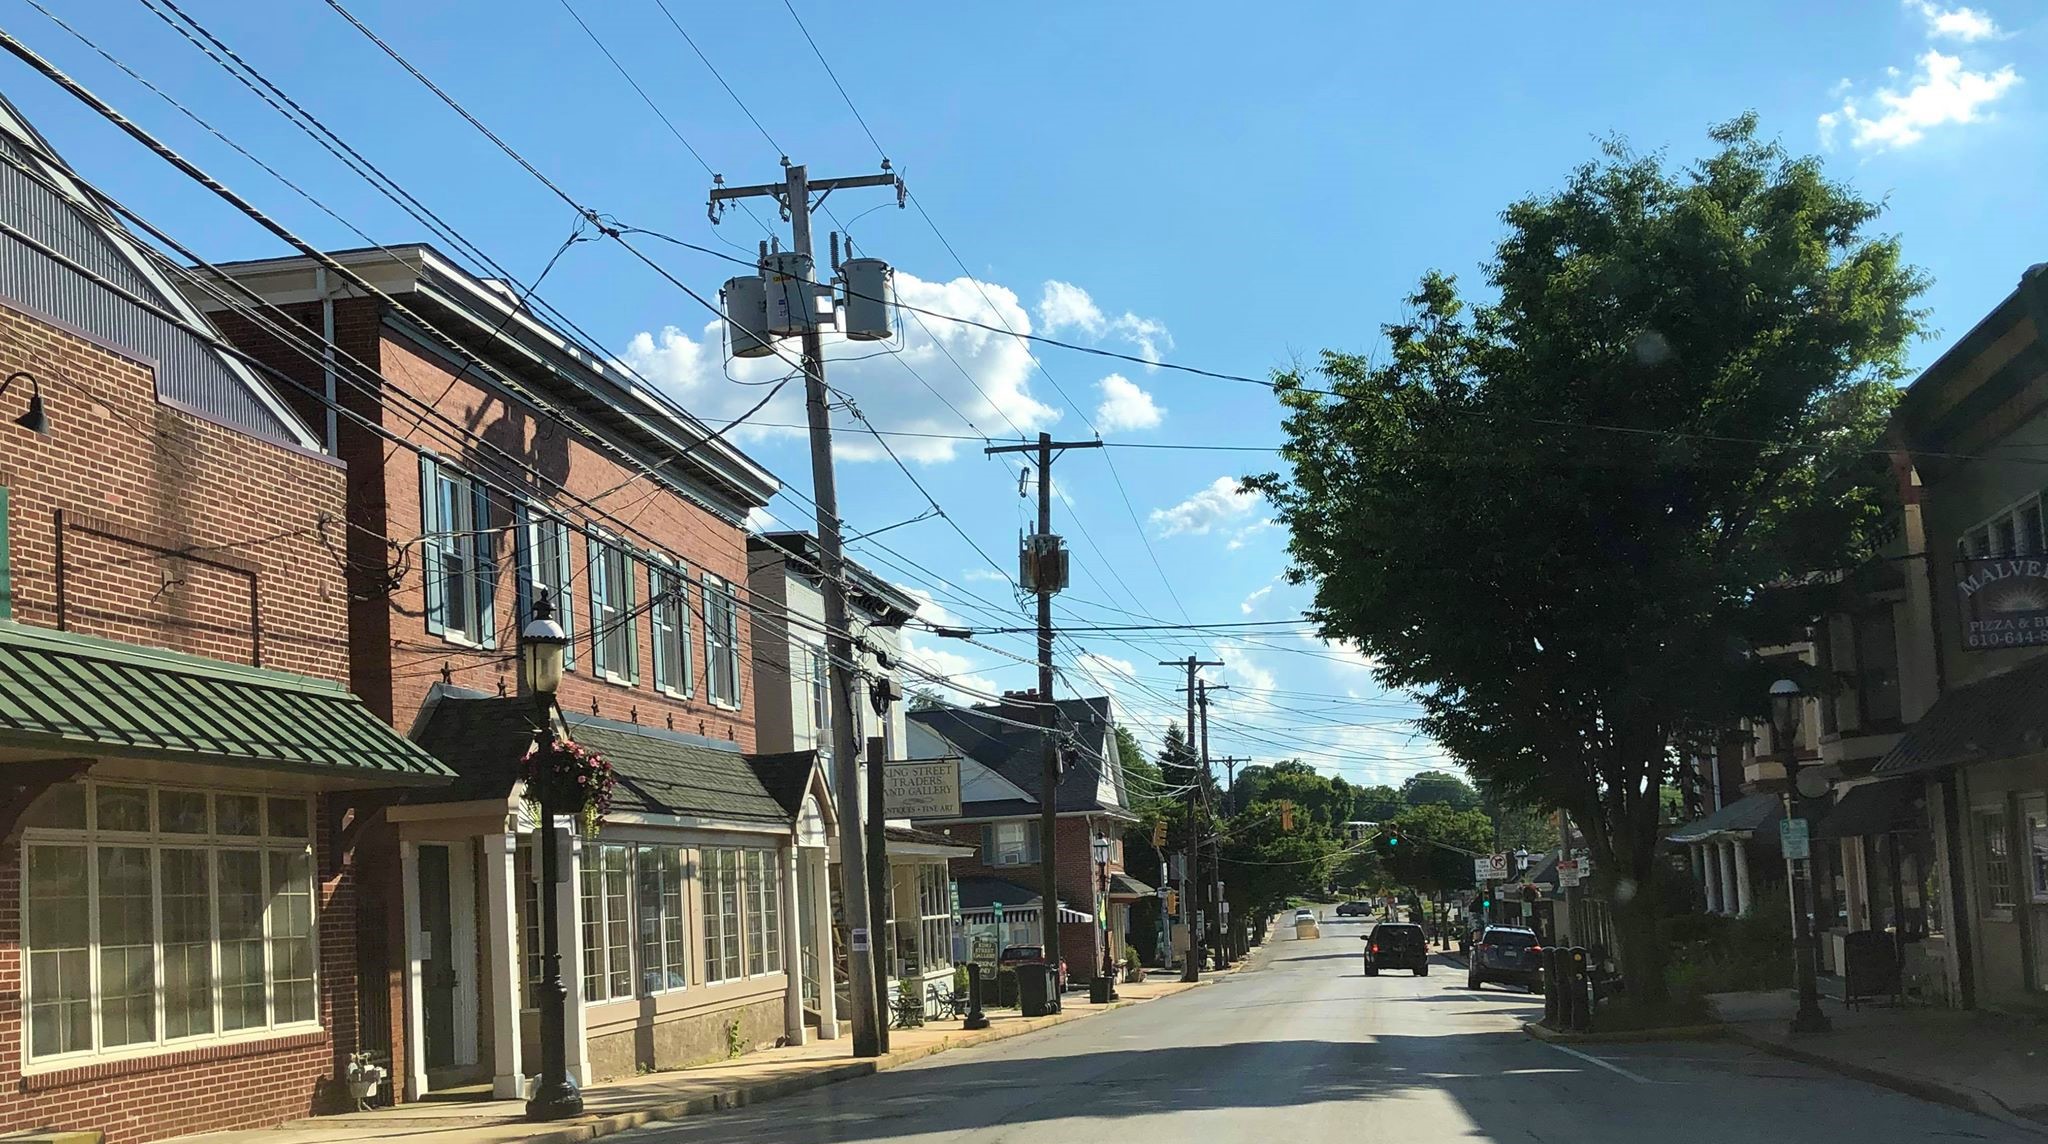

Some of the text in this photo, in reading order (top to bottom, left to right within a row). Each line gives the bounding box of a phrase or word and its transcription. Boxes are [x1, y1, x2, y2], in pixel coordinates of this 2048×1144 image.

[1969, 619, 2015, 633] PIZZA
[2018, 617, 2030, 629] &
[912, 765, 952, 776] STREET
[892, 776, 942, 787] TRADERS
[908, 785, 952, 796] GALLERY
[884, 804, 953, 815] NTIQUES FINE ART
